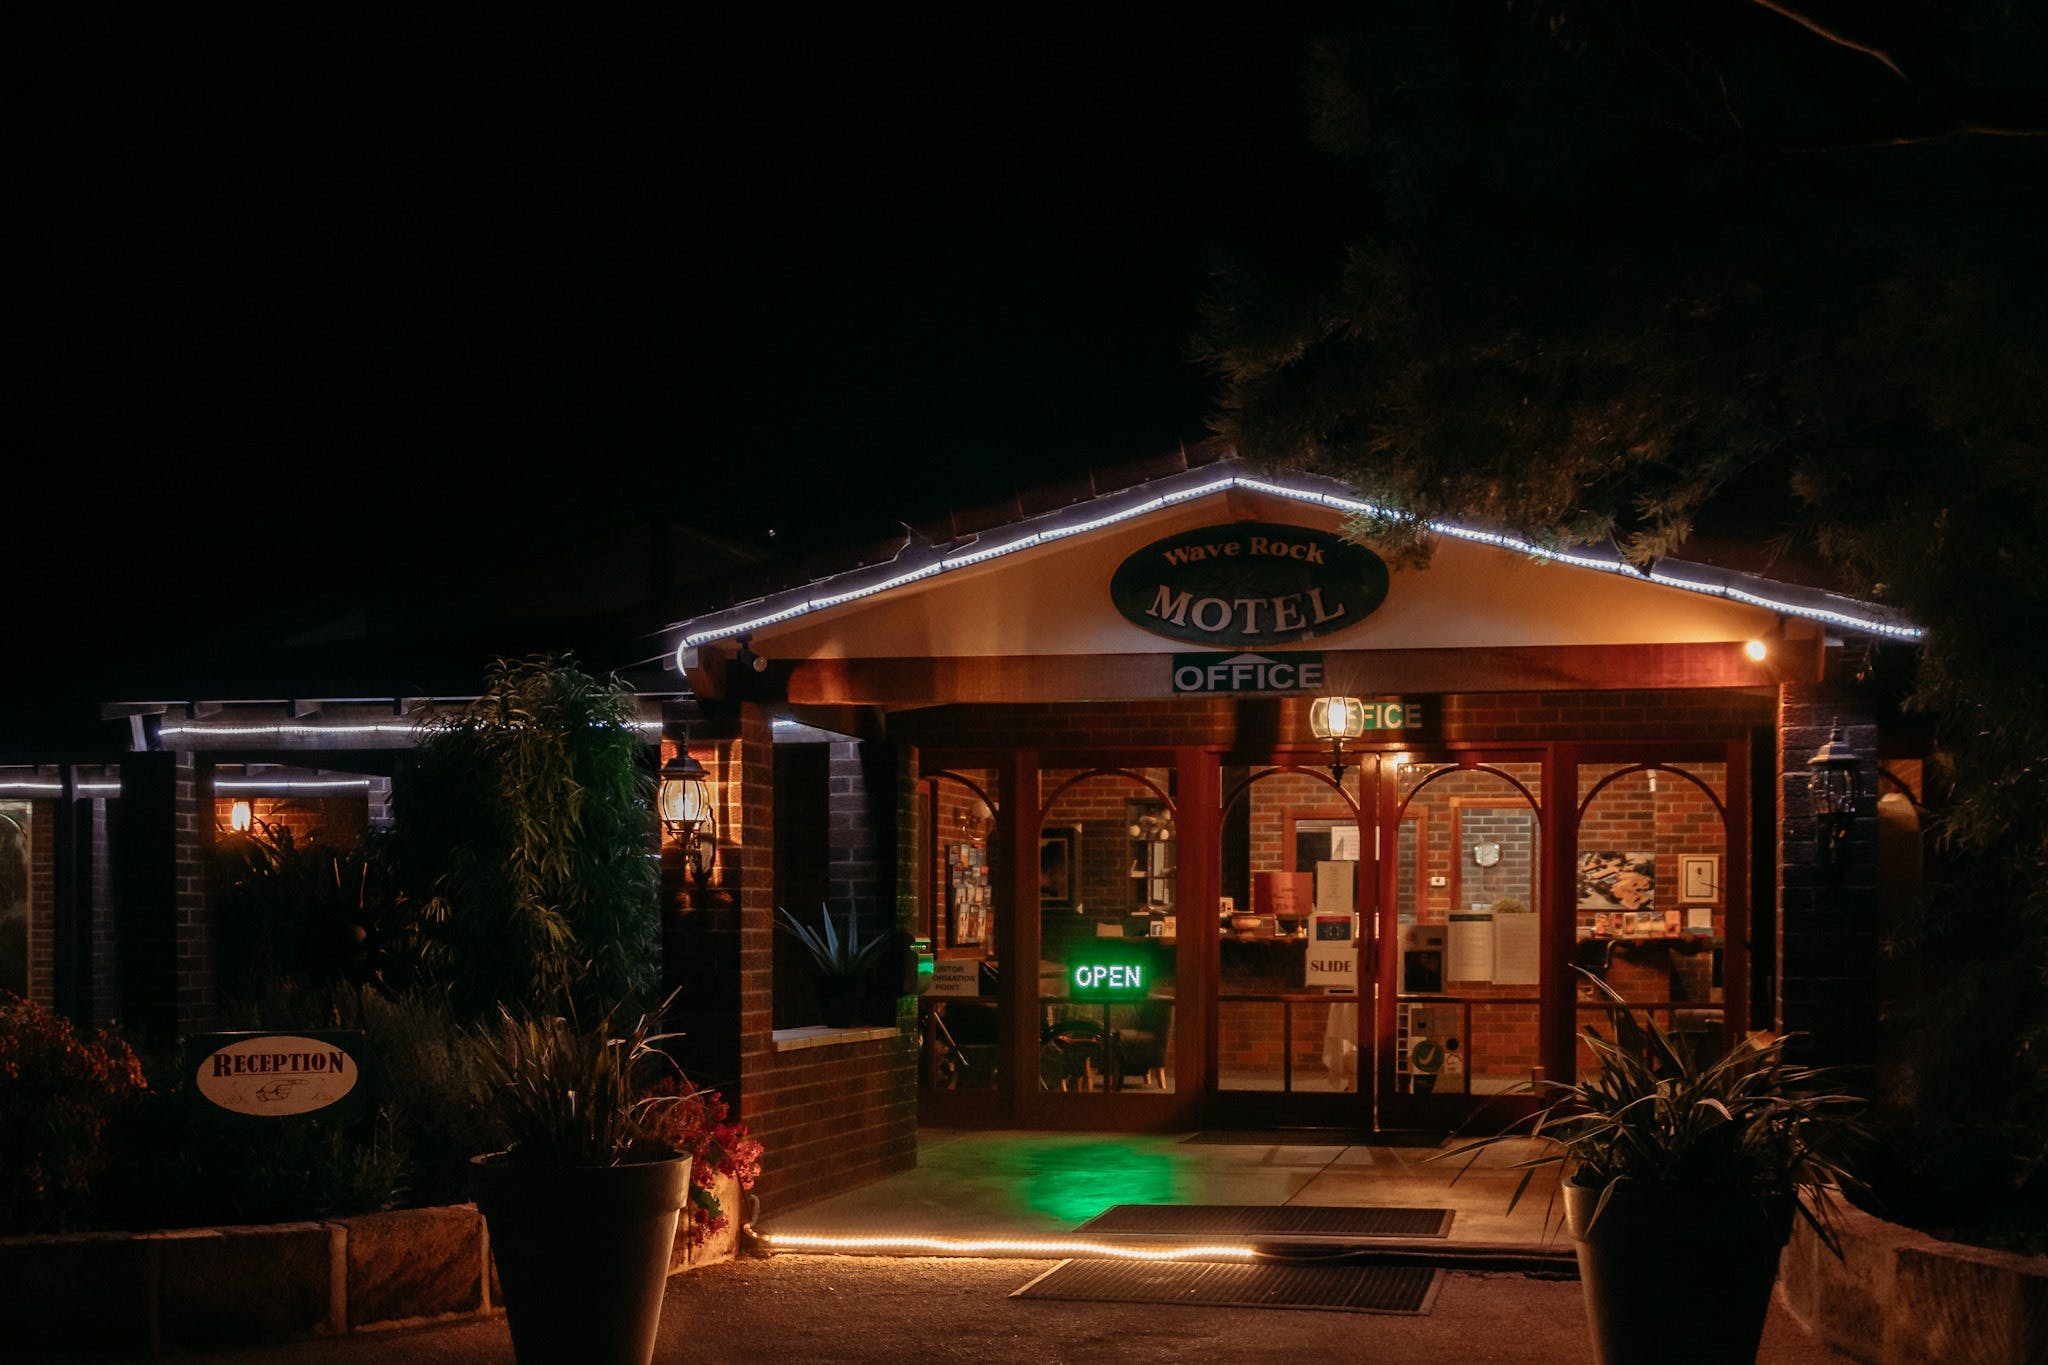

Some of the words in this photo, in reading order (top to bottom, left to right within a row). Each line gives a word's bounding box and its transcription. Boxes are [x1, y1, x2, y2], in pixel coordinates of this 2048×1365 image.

[1162, 541, 1241, 567] Wave
[1249, 537, 1325, 566] Rock
[1145, 584, 1345, 635] MOTEL
[1174, 663, 1323, 690] OFFICE
[1076, 965, 1141, 987] OPEN
[1311, 960, 1353, 972] SLIDE
[212, 1051, 345, 1077] RECEPTION
